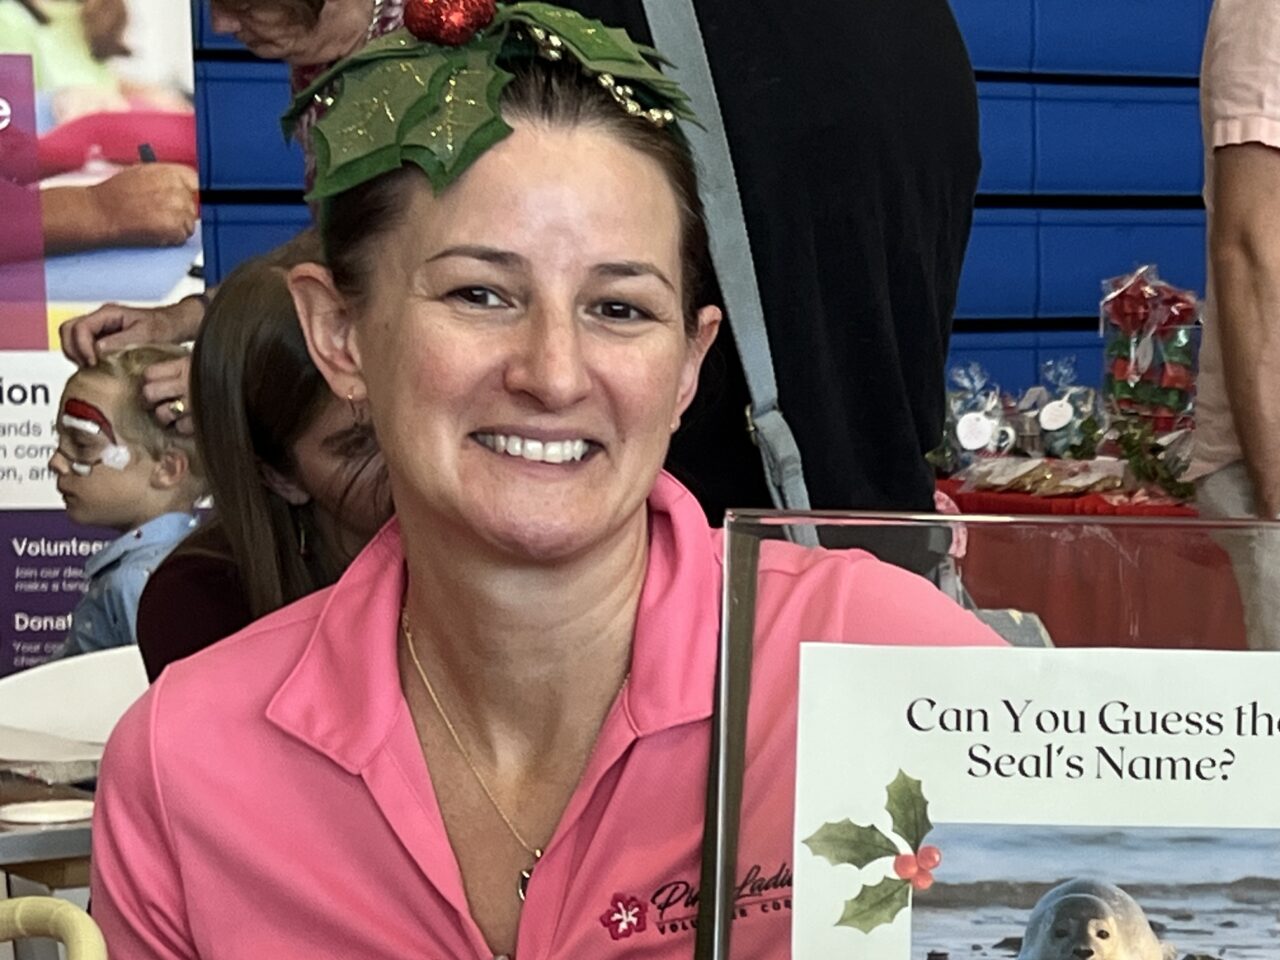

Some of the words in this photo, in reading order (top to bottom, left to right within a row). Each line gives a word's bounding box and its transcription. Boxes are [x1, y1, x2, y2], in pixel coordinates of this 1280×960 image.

[14, 611, 73, 632] Donat
[906, 697, 990, 732] Can
[1001, 699, 1087, 734] You
[1098, 700, 1225, 736] Guess
[966, 742, 1085, 779] Seal's
[1094, 745, 1236, 781] Name?
